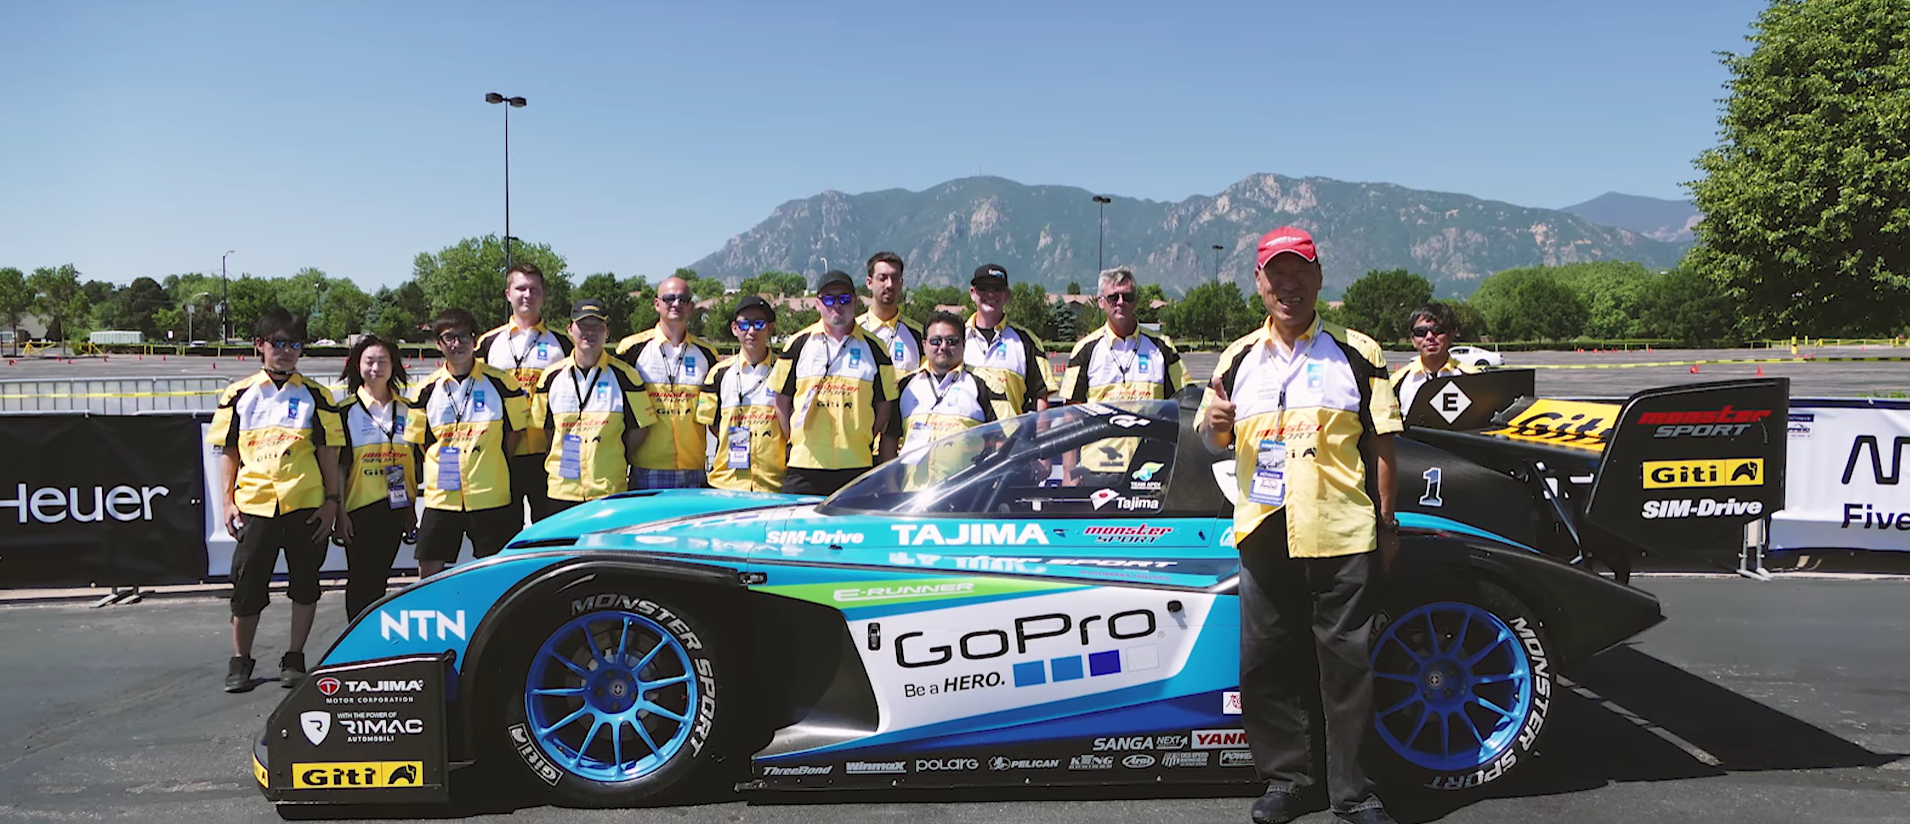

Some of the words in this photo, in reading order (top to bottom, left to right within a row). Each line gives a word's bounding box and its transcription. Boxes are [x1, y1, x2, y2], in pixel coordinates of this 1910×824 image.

[1443, 393, 1458, 411] E
[1637, 405, 1773, 425] monster
[1654, 424, 1751, 438] SPORT
[1651, 465, 1717, 483] Giti
[1419, 467, 1442, 506] 1
[1116, 496, 1159, 512] Tajima
[1642, 498, 1763, 519] SIM-Drive
[766, 529, 864, 544] SIM-Drive
[891, 523, 1050, 545] TAJIMA
[1083, 523, 1174, 536] monster
[1096, 535, 1160, 543] SPORT
[833, 582, 975, 602] E-RUNNER
[381, 610, 466, 642] NTN
[894, 609, 1156, 669] GoPro
[570, 593, 703, 651] MONSTER
[690, 657, 717, 758] SPORT
[1509, 616, 1551, 752] MONSTER
[345, 680, 423, 692] TAJIMA
[904, 684, 926, 698] Be
[930, 684, 939, 695] a
[943, 672, 1006, 693] HERO.
[339, 719, 424, 734] RIMAC
[1093, 736, 1154, 751] SANGA
[1156, 736, 1182, 744] NEXT
[763, 765, 833, 776] ThreeBond
[1010, 758, 1060, 769] PELICAN
[1424, 748, 1518, 791] SPORT
[302, 768, 376, 786] Giti
